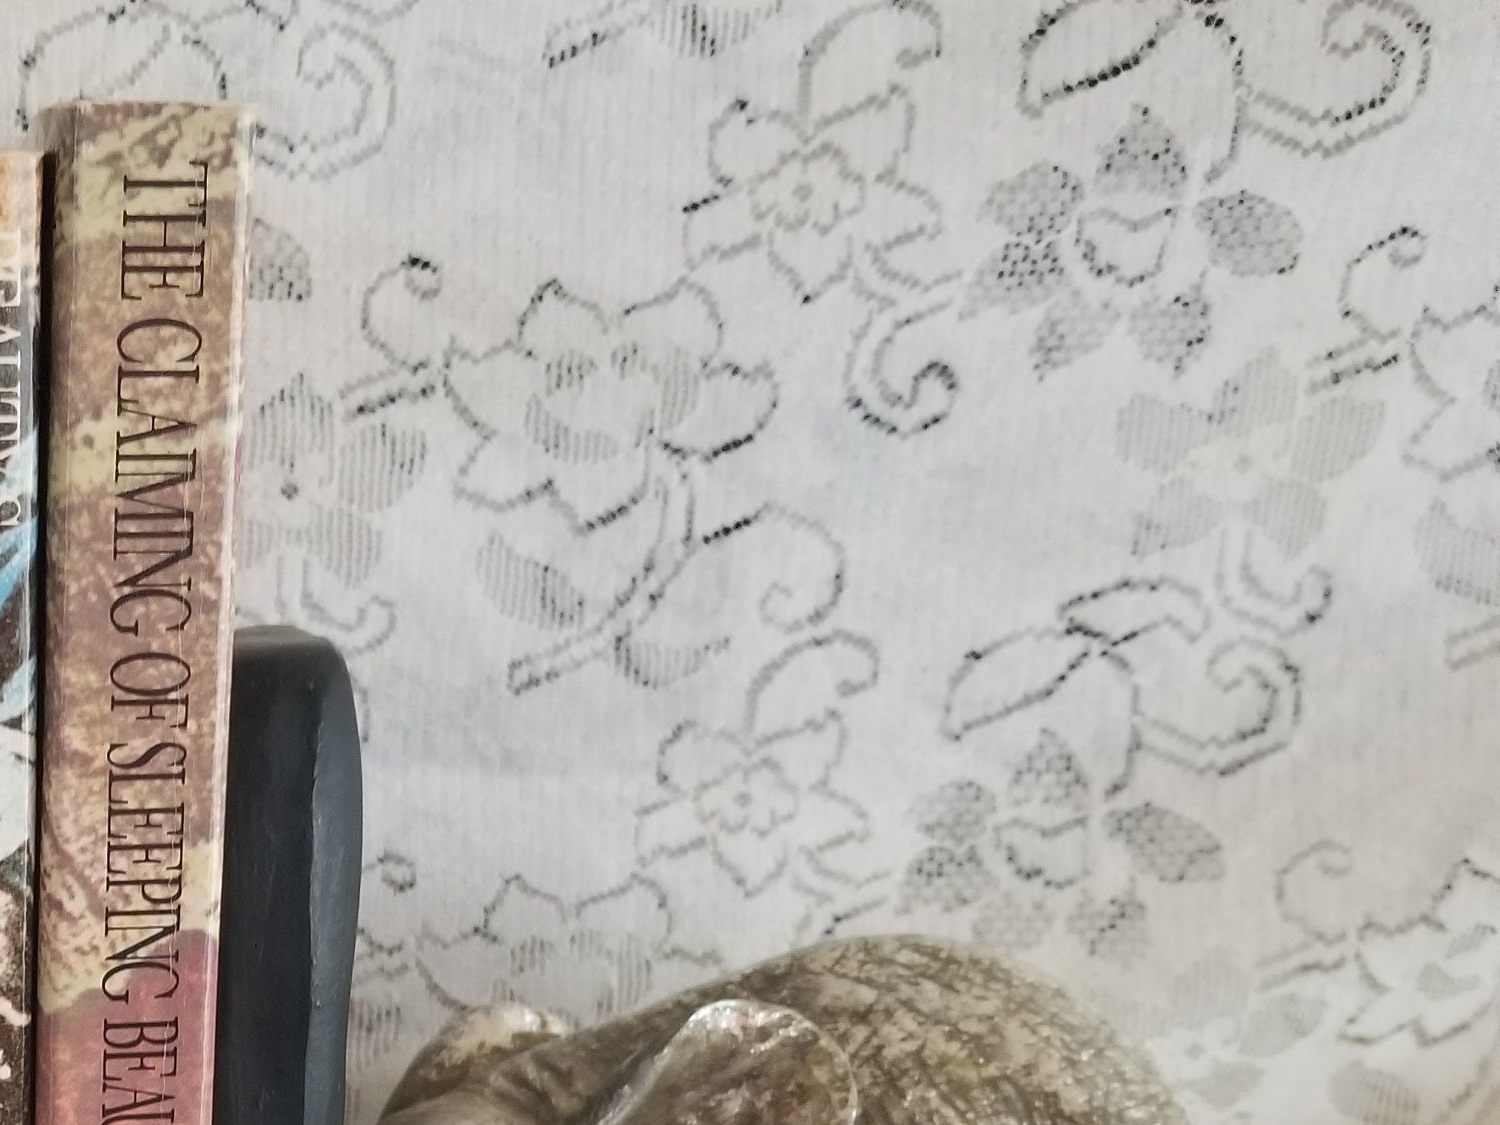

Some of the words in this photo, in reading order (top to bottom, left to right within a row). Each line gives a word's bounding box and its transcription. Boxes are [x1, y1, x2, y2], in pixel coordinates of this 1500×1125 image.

[120, 160, 208, 300] THE
[110, 317, 202, 637] CLAIMING
[110, 651, 192, 730] OF
[100, 742, 187, 1004] SLEEPING
